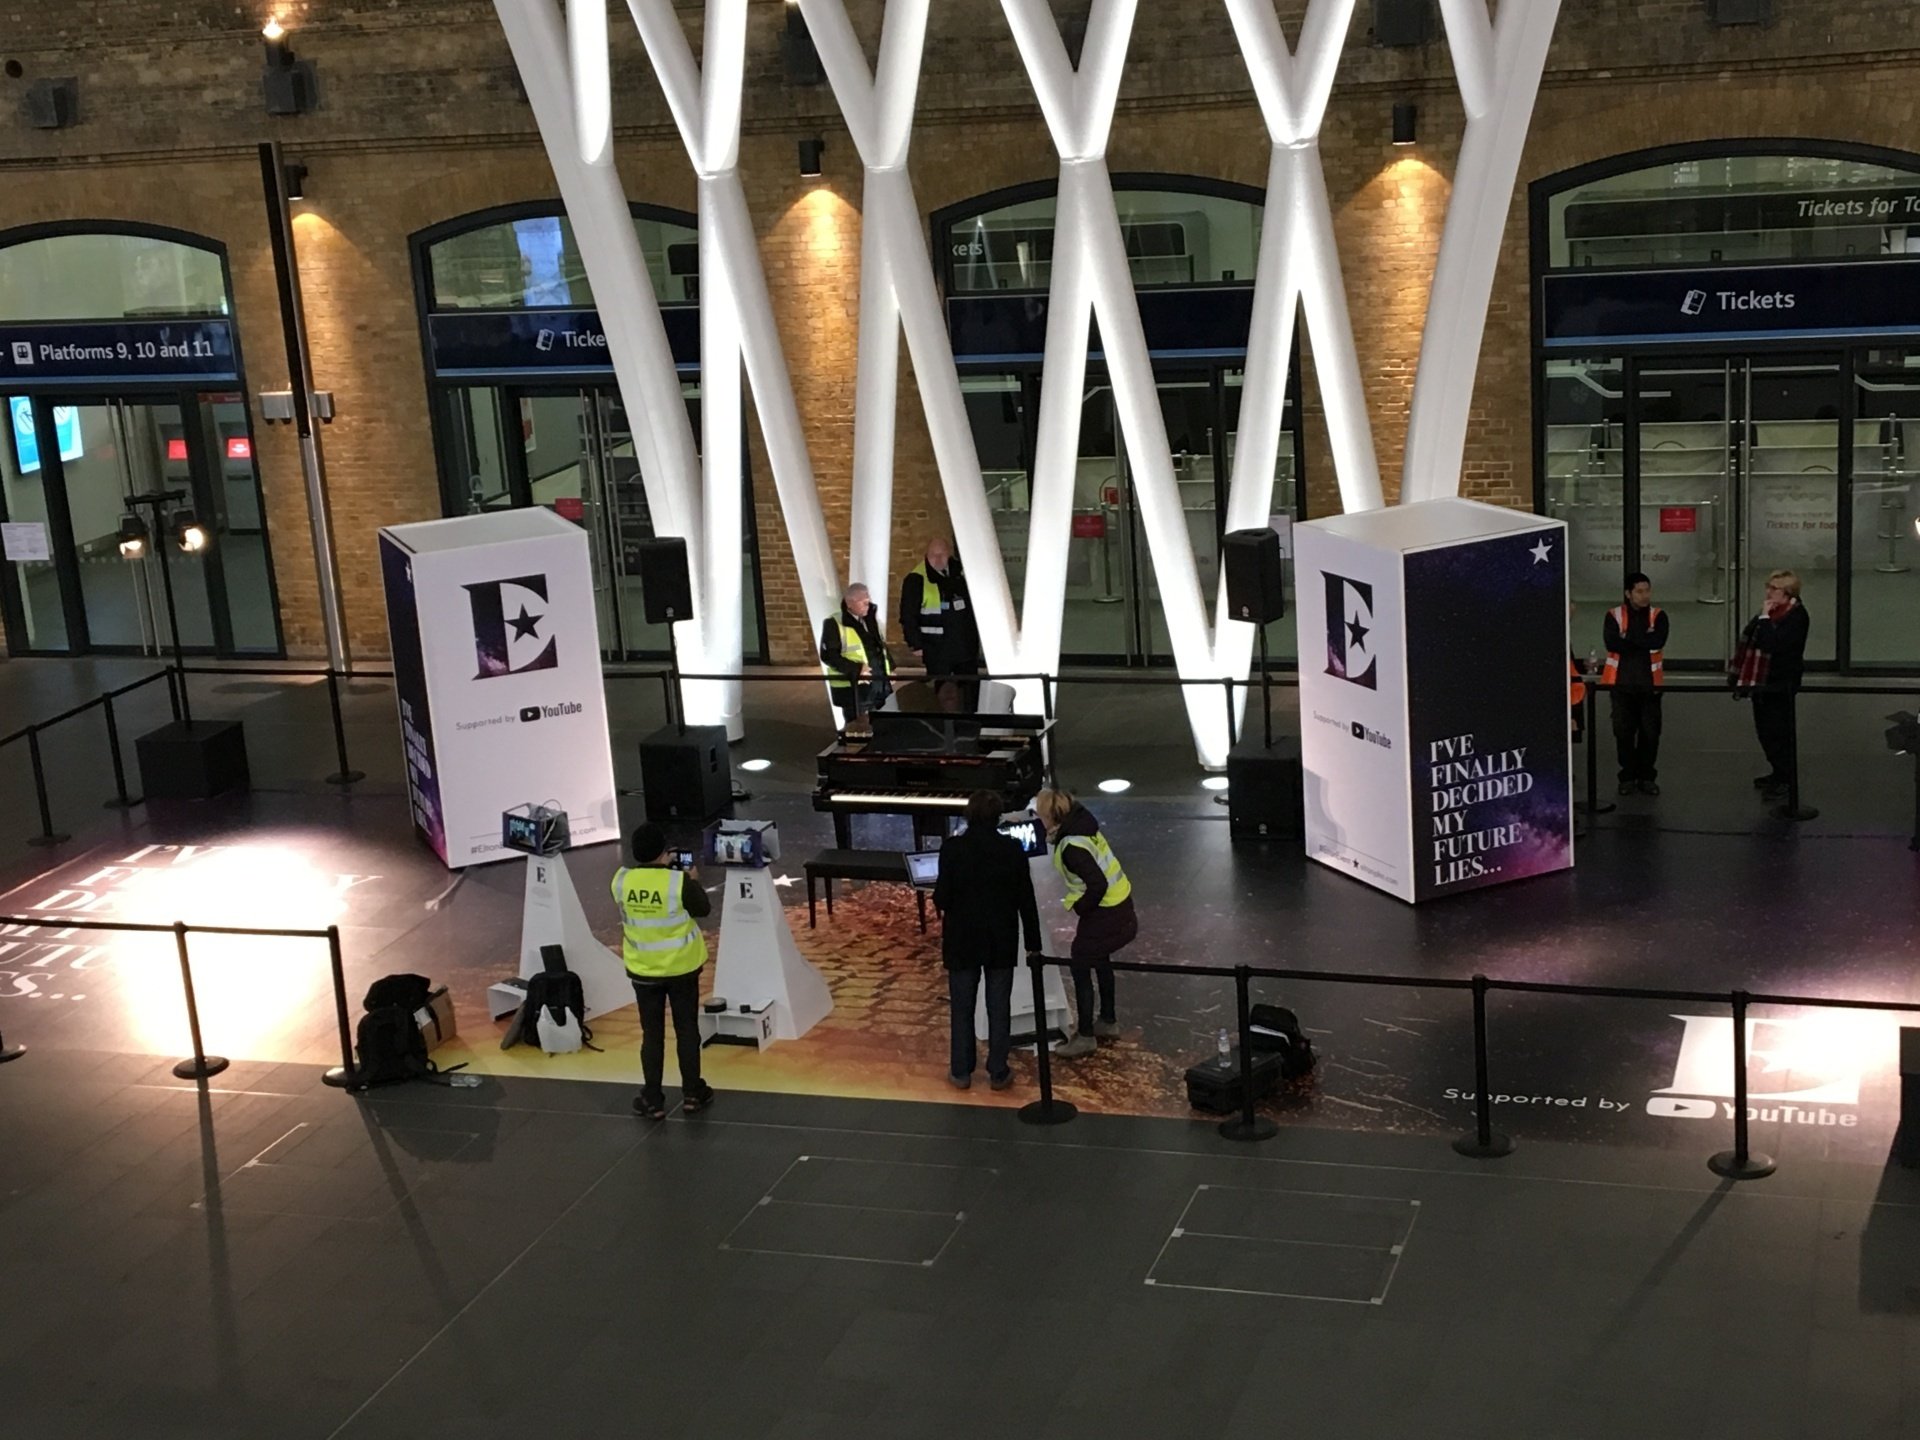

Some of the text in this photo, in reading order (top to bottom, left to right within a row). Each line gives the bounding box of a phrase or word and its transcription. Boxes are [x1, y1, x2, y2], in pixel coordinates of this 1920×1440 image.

[1798, 196, 1920, 217] Tickets for To
[1716, 290, 1795, 310] Tickets
[561, 329, 607, 347] Ticke
[39, 341, 214, 361] Platforms 9, 10 and 11
[455, 702, 582, 731] Supported by YouTube
[1431, 747, 1528, 788] FINALLY
[1432, 772, 1533, 812] DECIDED
[1432, 809, 1468, 837] MY
[1433, 822, 1524, 861] FUTURE
[627, 889, 663, 905] APA
[1599, 1098, 1631, 1112] by
